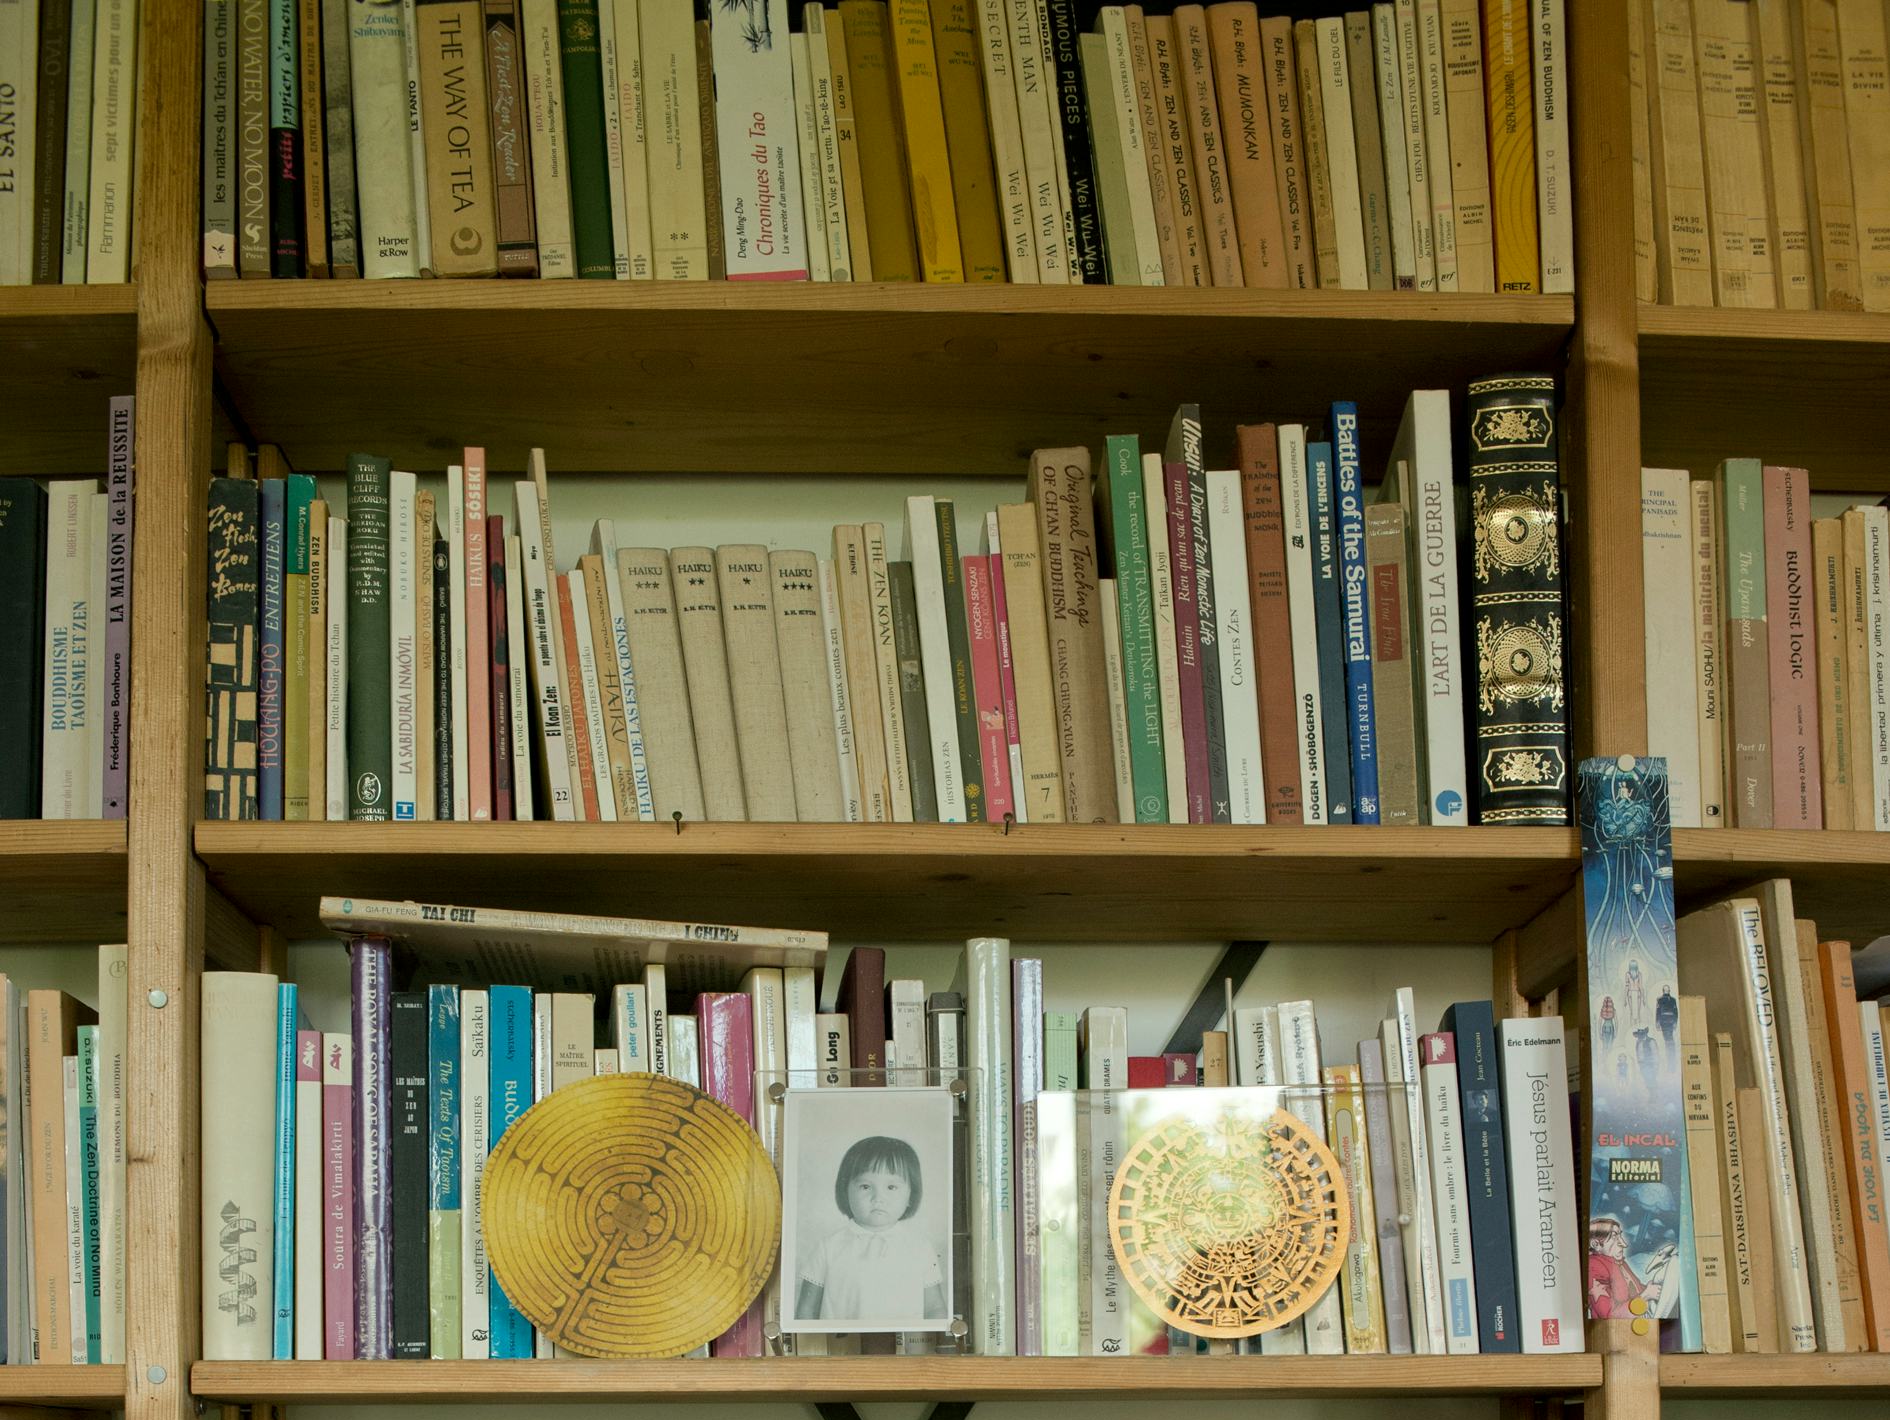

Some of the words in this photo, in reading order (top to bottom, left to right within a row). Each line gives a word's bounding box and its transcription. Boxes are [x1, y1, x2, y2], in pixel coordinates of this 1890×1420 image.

[213, 1, 227, 38] Chine
[440, 13, 462, 59] THE
[217, 42, 227, 58] en
[443, 66, 468, 119] WAY
[1065, 71, 1080, 123] PIECES
[1542, 66, 1553, 120] BUDDHISM
[213, 105, 226, 123] du
[749, 112, 766, 138] Tao
[1236, 74, 1259, 160] MUMONKAN
[212, 127, 226, 179] maîtres
[448, 126, 472, 158] OF
[752, 144, 768, 164] du
[213, 183, 226, 203] les
[449, 165, 475, 213] TEA
[100, 182, 116, 253] Flammarion
[735, 197, 746, 235] Ming-Dao
[753, 169, 776, 256] Chroniques
[378, 237, 410, 247] Harper
[736, 238, 748, 259] Deng
[1503, 282, 1531, 291] RETZ
[111, 409, 128, 484] REUSSITE
[1337, 413, 1357, 490] Battles
[113, 490, 126, 503] la
[467, 467, 482, 520] SÔSEKI
[1340, 497, 1361, 520] of
[113, 510, 125, 525] de
[1425, 481, 1443, 567] GUERRE
[1696, 490, 1710, 537] mental
[469, 533, 483, 587] HAIKUS
[1343, 524, 1361, 559] the
[1698, 544, 1711, 559] du
[110, 533, 125, 597] MAISON
[265, 521, 280, 630] ENTRETIENS
[628, 567, 662, 576] HAIKU
[1156, 551, 1169, 574] Jyoji
[1870, 526, 1881, 595] krishnamurti
[1158, 577, 1170, 608] Taïkan
[1429, 572, 1445, 598] LA
[73, 601, 87, 630] ZEN
[110, 604, 124, 622] LA
[1346, 566, 1369, 661] Samurai
[1431, 606, 1447, 634] DE
[72, 635, 86, 655] ET
[52, 627, 68, 730] BOUDDHISME
[1433, 640, 1451, 696] L'ART
[68, 659, 86, 730] TAOÏSME
[259, 644, 282, 768] HOUANG-PO
[1357, 683, 1370, 760] TURNBULL
[421, 905, 447, 922] TAI
[450, 907, 476, 924] CHI
[626, 992, 638, 1028] goullart
[470, 1006, 485, 1057] Saïkaku
[627, 1032, 639, 1057] peter
[555, 1059, 589, 1069] SPIRITUEL
[1528, 1072, 1550, 1123] Jésus
[1598, 1133, 1620, 1147] EL
[1624, 1133, 1676, 1147] INCAL
[1725, 1101, 1739, 1167] BHASHYA
[1533, 1124, 1554, 1192] parlait
[1611, 1160, 1660, 1173] NORMA
[1611, 1173, 1660, 1181] Editorial
[331, 1205, 343, 1219] de
[1730, 1173, 1750, 1285] SAT-DARSHANA
[1537, 1199, 1557, 1289] Araméen
[335, 1321, 346, 1346] Fayard
